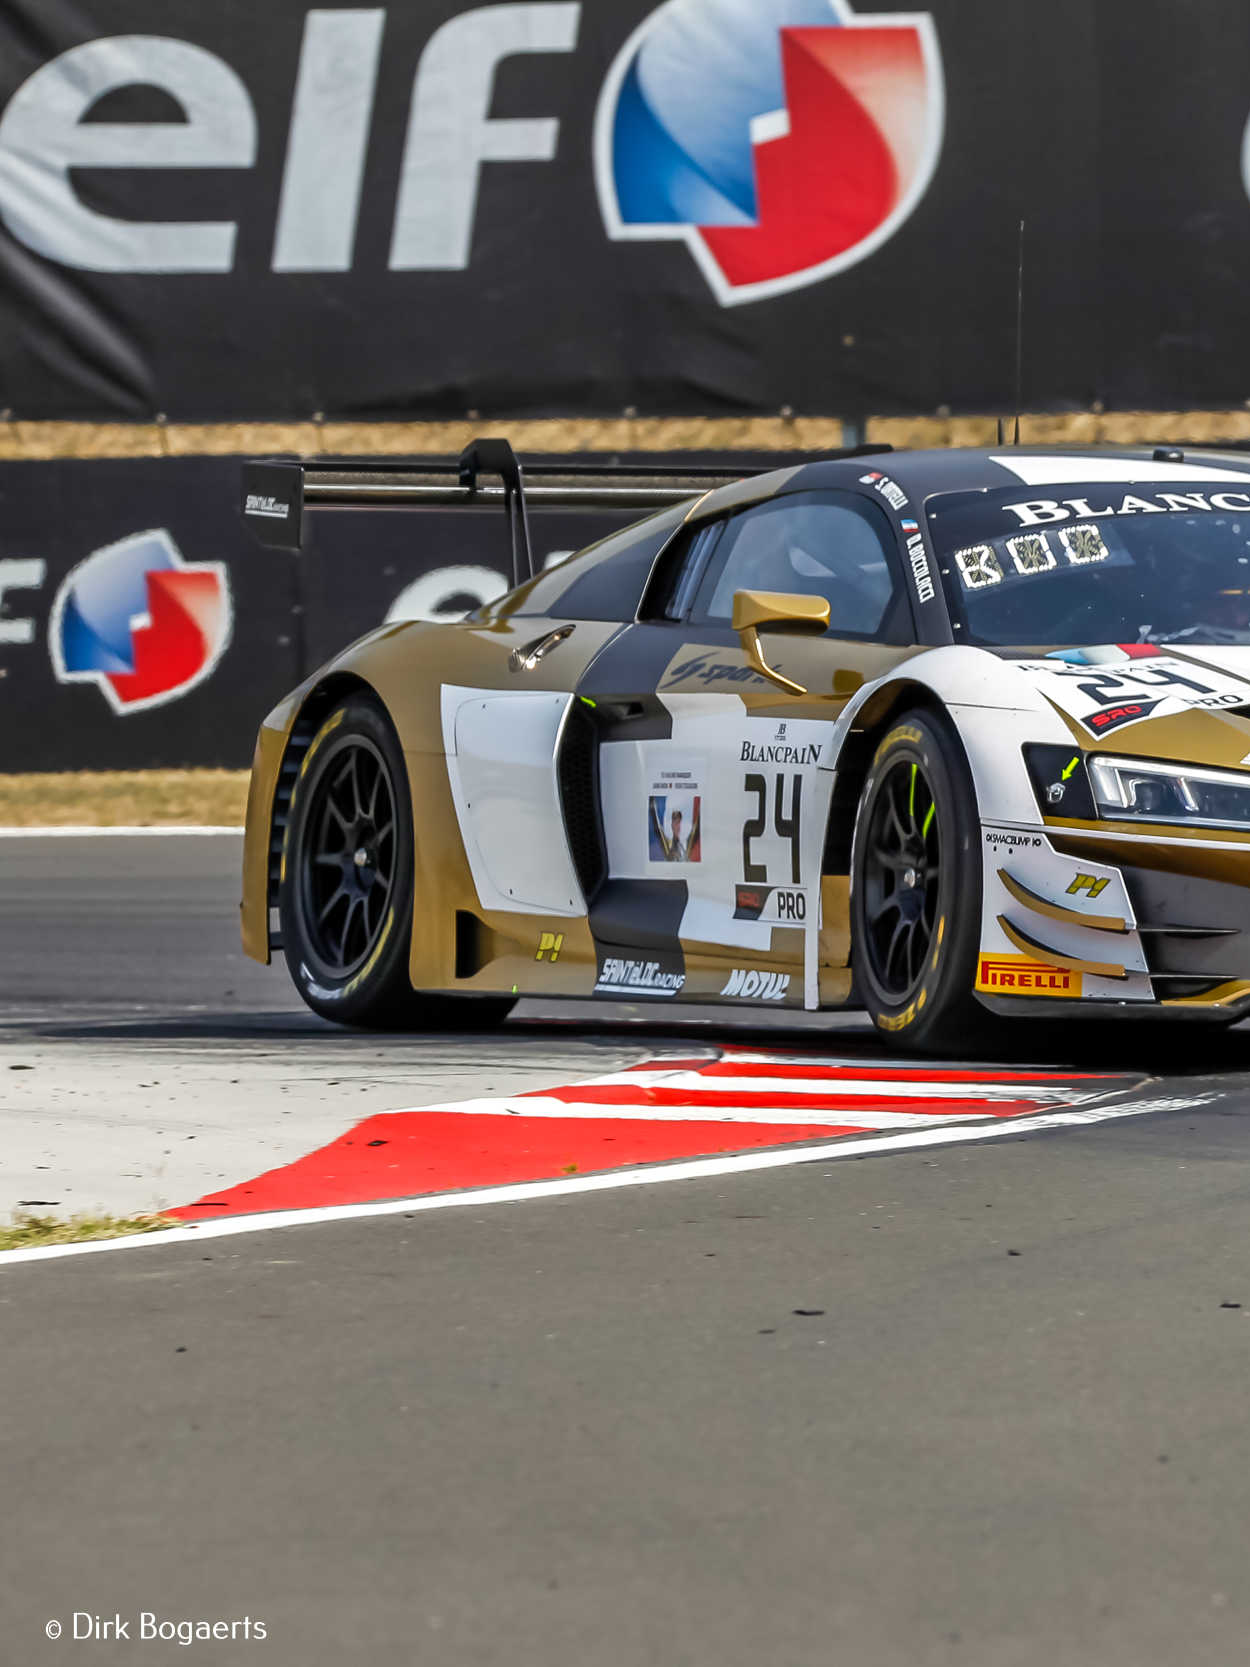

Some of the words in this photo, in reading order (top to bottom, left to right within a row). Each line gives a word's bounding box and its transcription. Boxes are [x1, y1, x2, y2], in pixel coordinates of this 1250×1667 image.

[0, 2, 580, 273] elf
[1051, 669, 1218, 706] 24
[1091, 705, 1142, 727] SRO
[740, 740, 823, 765] BLANCPAIN
[742, 773, 803, 884] 24
[777, 891, 806, 920] PRO
[981, 961, 1070, 989] PIRELLI
